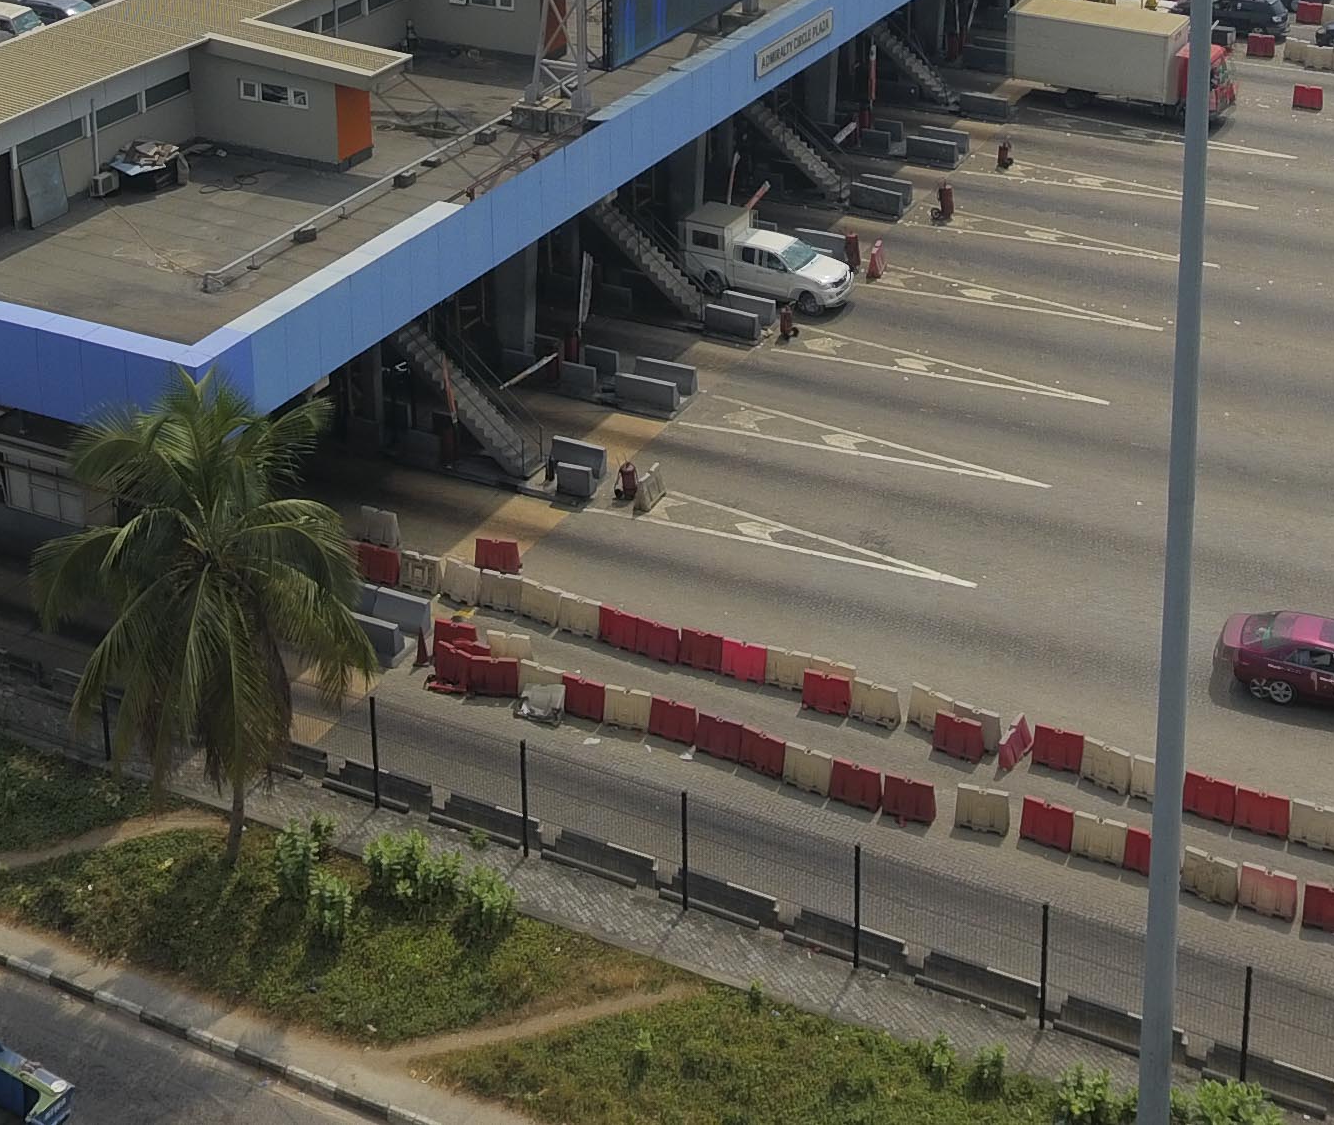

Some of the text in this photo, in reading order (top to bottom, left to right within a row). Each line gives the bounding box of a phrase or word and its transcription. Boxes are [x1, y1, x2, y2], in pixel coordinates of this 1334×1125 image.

[761, 18, 830, 69] ADMIRALTY CIRCLE PLAZA
